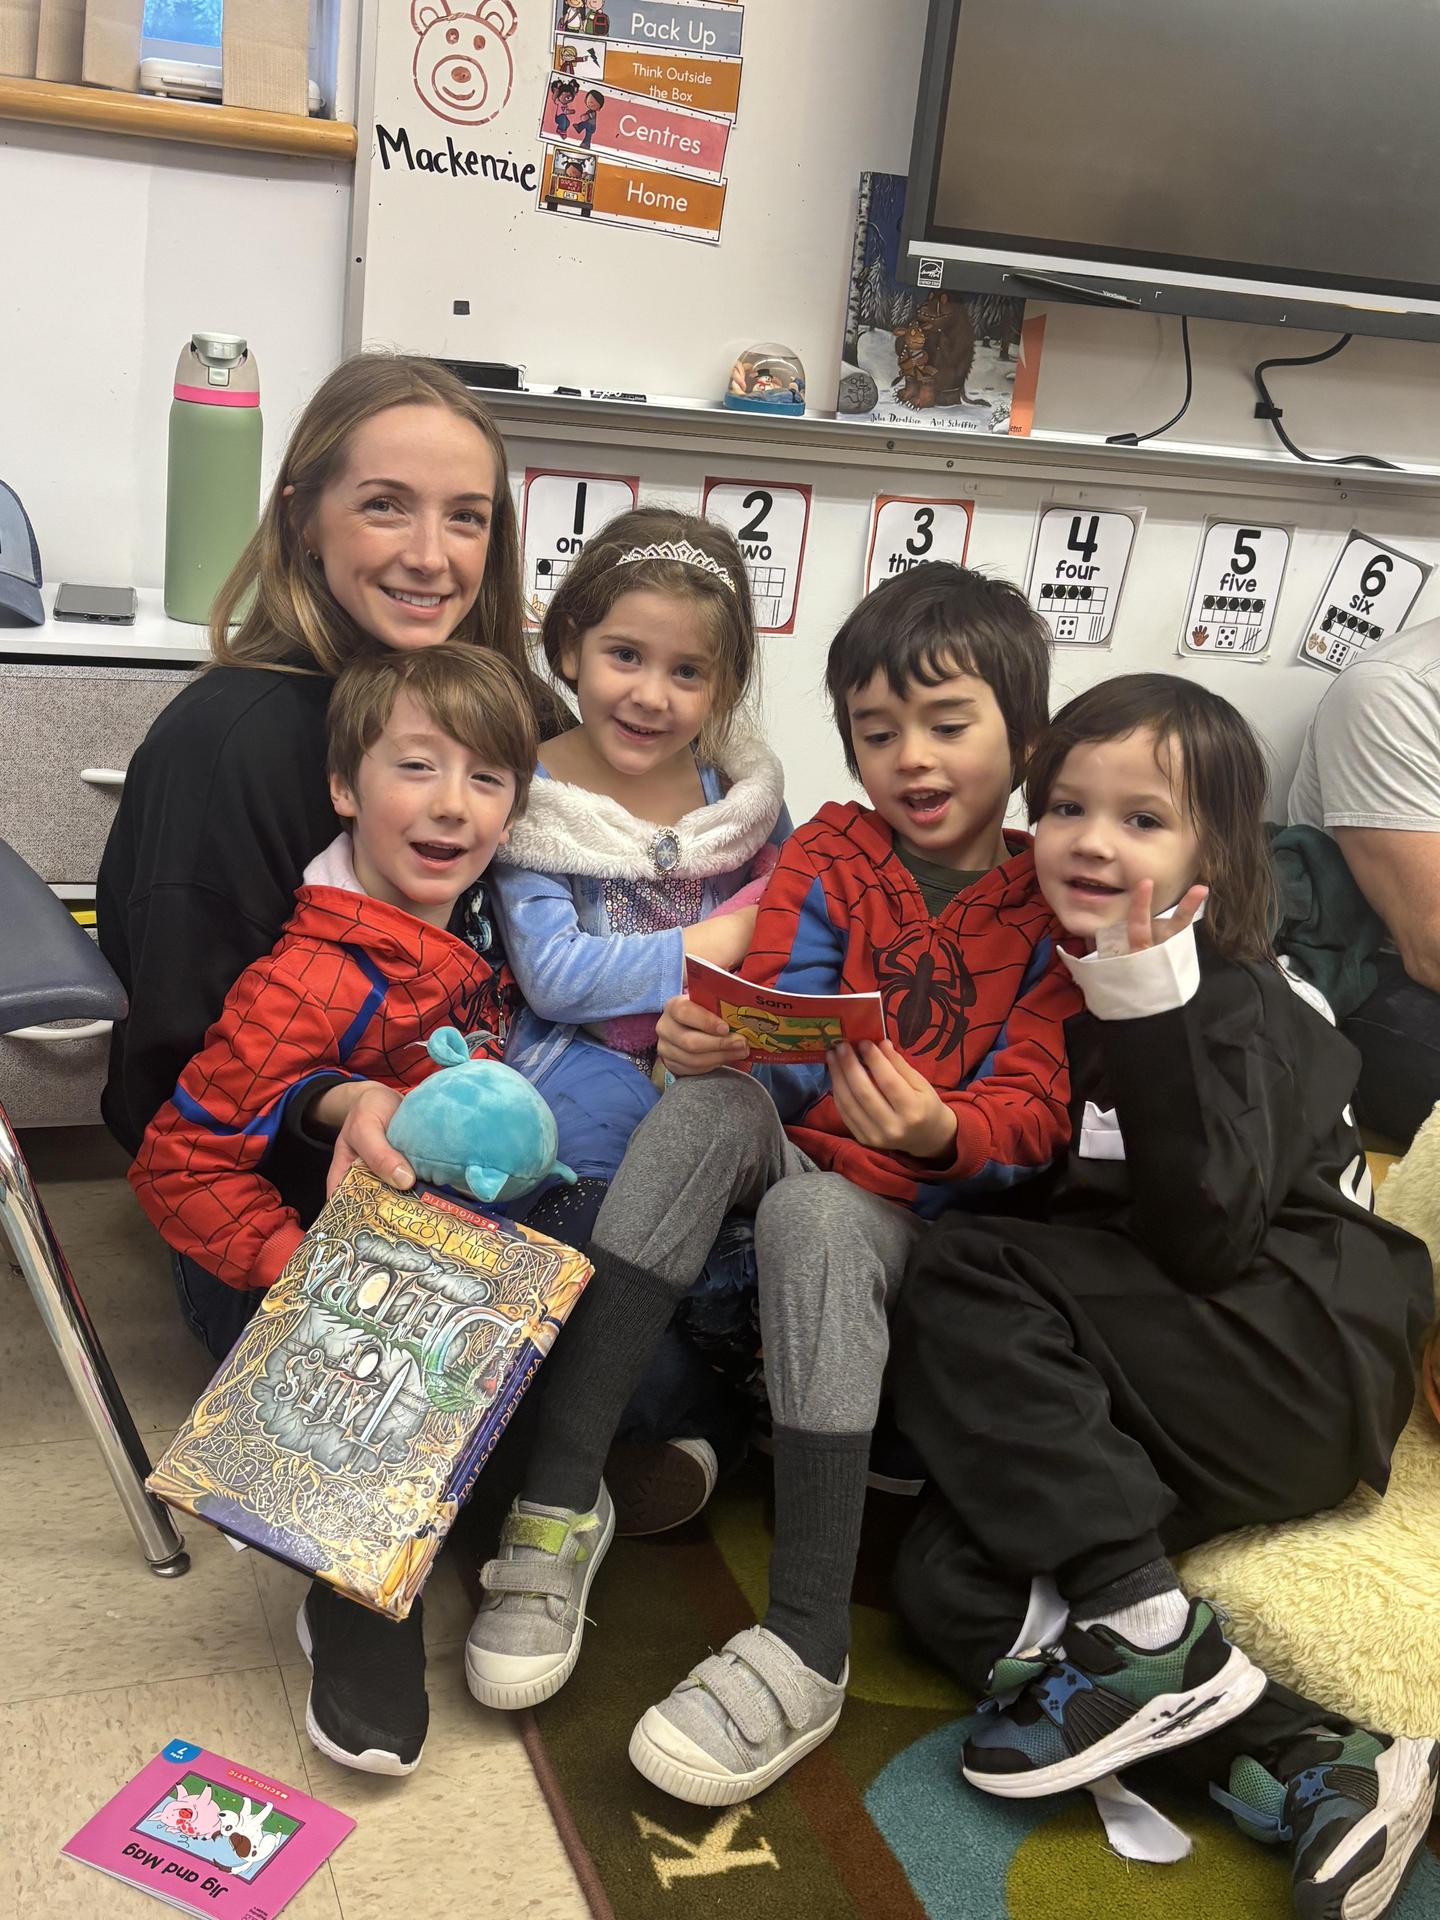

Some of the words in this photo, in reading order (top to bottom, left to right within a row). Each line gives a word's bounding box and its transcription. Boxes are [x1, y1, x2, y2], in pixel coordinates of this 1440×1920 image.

[631, 12, 680, 41] Pack
[688, 20, 716, 50] Up
[632, 62, 663, 80] Think
[666, 67, 713, 85] Outside
[649, 85, 668, 99] the
[671, 87, 693, 103] Box
[619, 114, 701, 154] Centres
[375, 123, 537, 192] Mackenzie
[627, 180, 688, 212] Home
[738, 490, 773, 542] 2
[556, 537, 584, 555] on
[906, 507, 935, 556] 3
[1067, 515, 1100, 562] 4
[736, 541, 772, 560] wo
[1230, 528, 1262, 575] 5
[1055, 559, 1100, 581] four
[1219, 573, 1257, 593] five
[1360, 554, 1394, 597] 6
[1349, 594, 1375, 616] six
[755, 995, 793, 1010] Sam
[424, 1195, 488, 1225] SCHOLASTIC
[444, 1220, 484, 1246] MARC
[451, 1241, 500, 1272] EMILY
[302, 1233, 528, 1374] DELTORA
[339, 1342, 380, 1380] OF
[274, 1348, 412, 1457] TALES
[177, 1747, 188, 1755] 7
[228, 1769, 281, 1796] SCHOLASTIC
[122, 1842, 164, 1869] Mag
[632, 1803, 780, 1889] K
[161, 1862, 199, 1883] and
[200, 1877, 229, 1899] Jig
